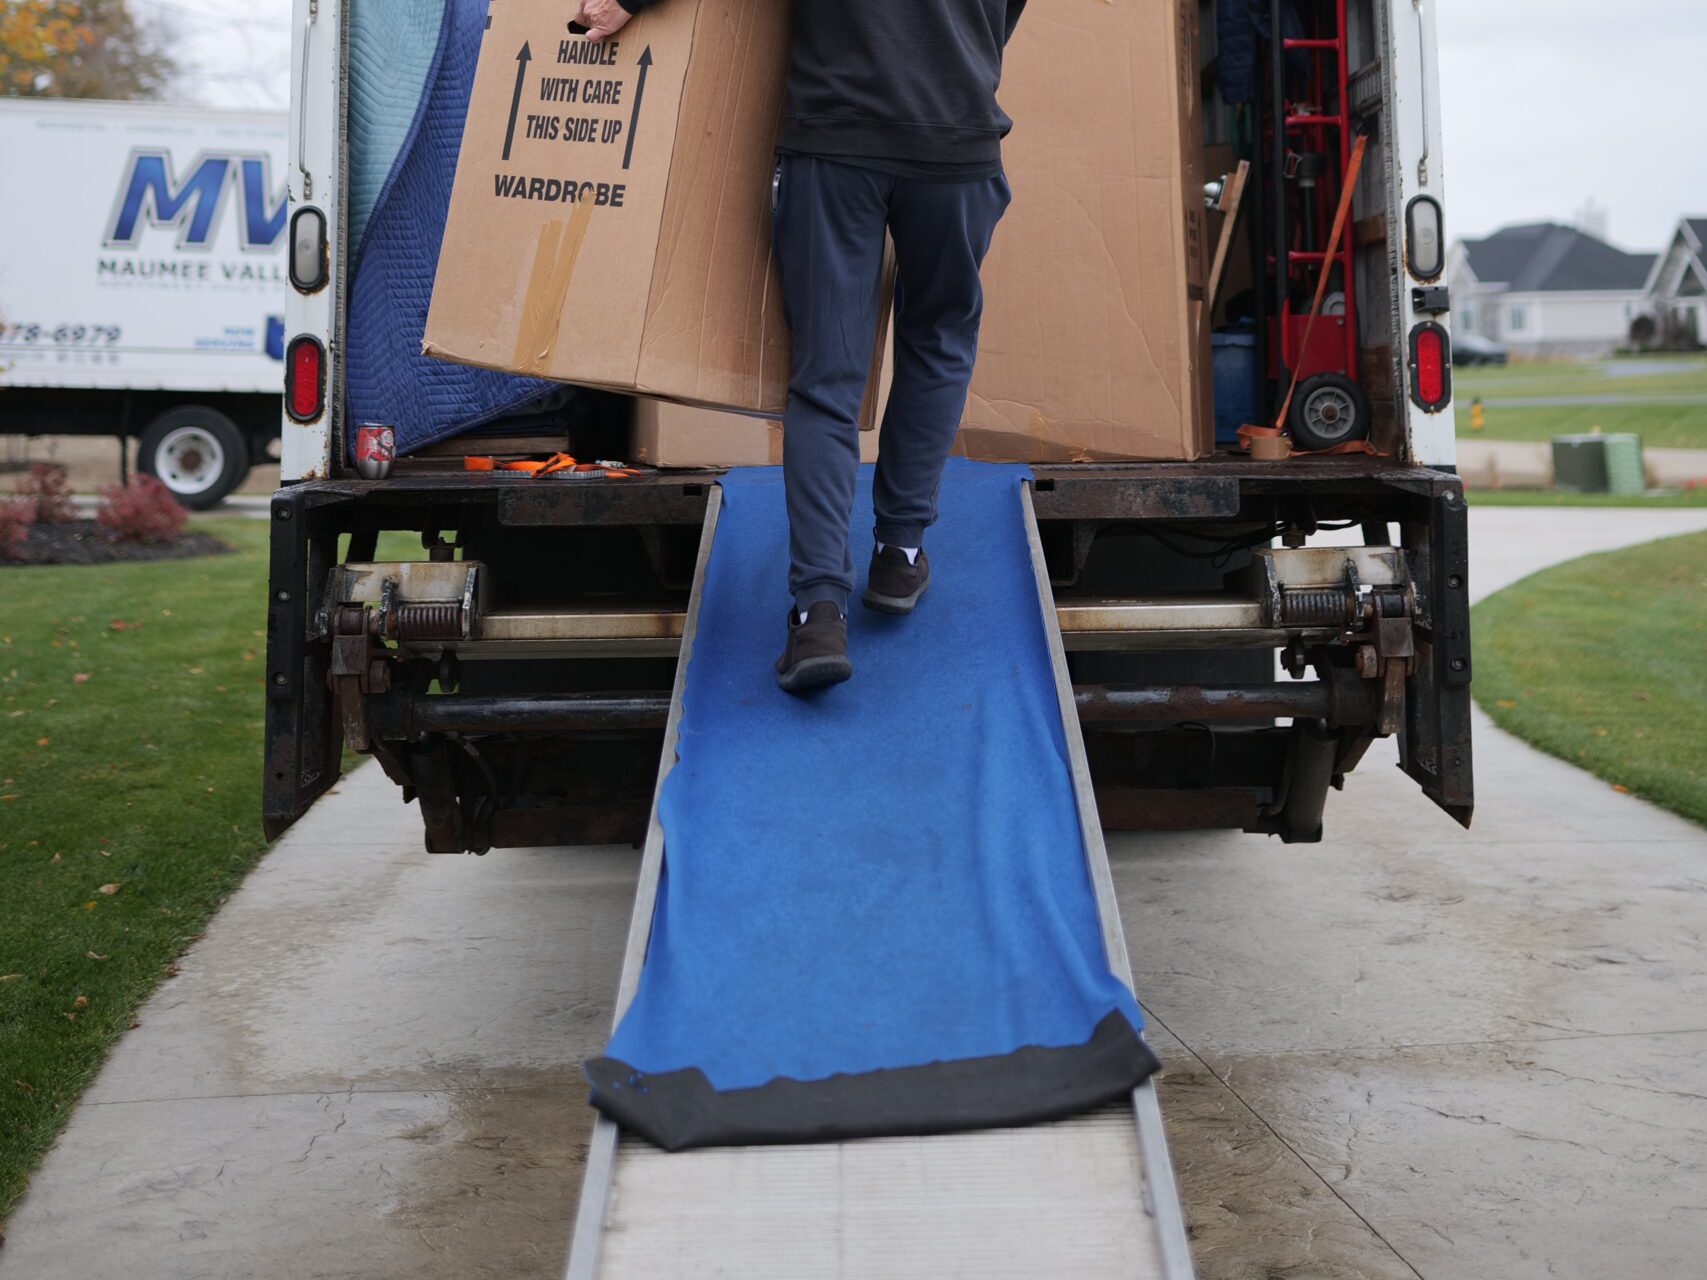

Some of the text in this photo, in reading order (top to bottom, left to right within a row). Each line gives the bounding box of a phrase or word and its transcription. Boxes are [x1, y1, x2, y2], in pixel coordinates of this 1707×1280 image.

[557, 40, 620, 65] HANDLE
[540, 77, 623, 104] WITH CARE
[526, 115, 623, 144] THIS SIDE UP
[494, 173, 626, 207] WARDROBE
[98, 259, 210, 280] MAUMEE
